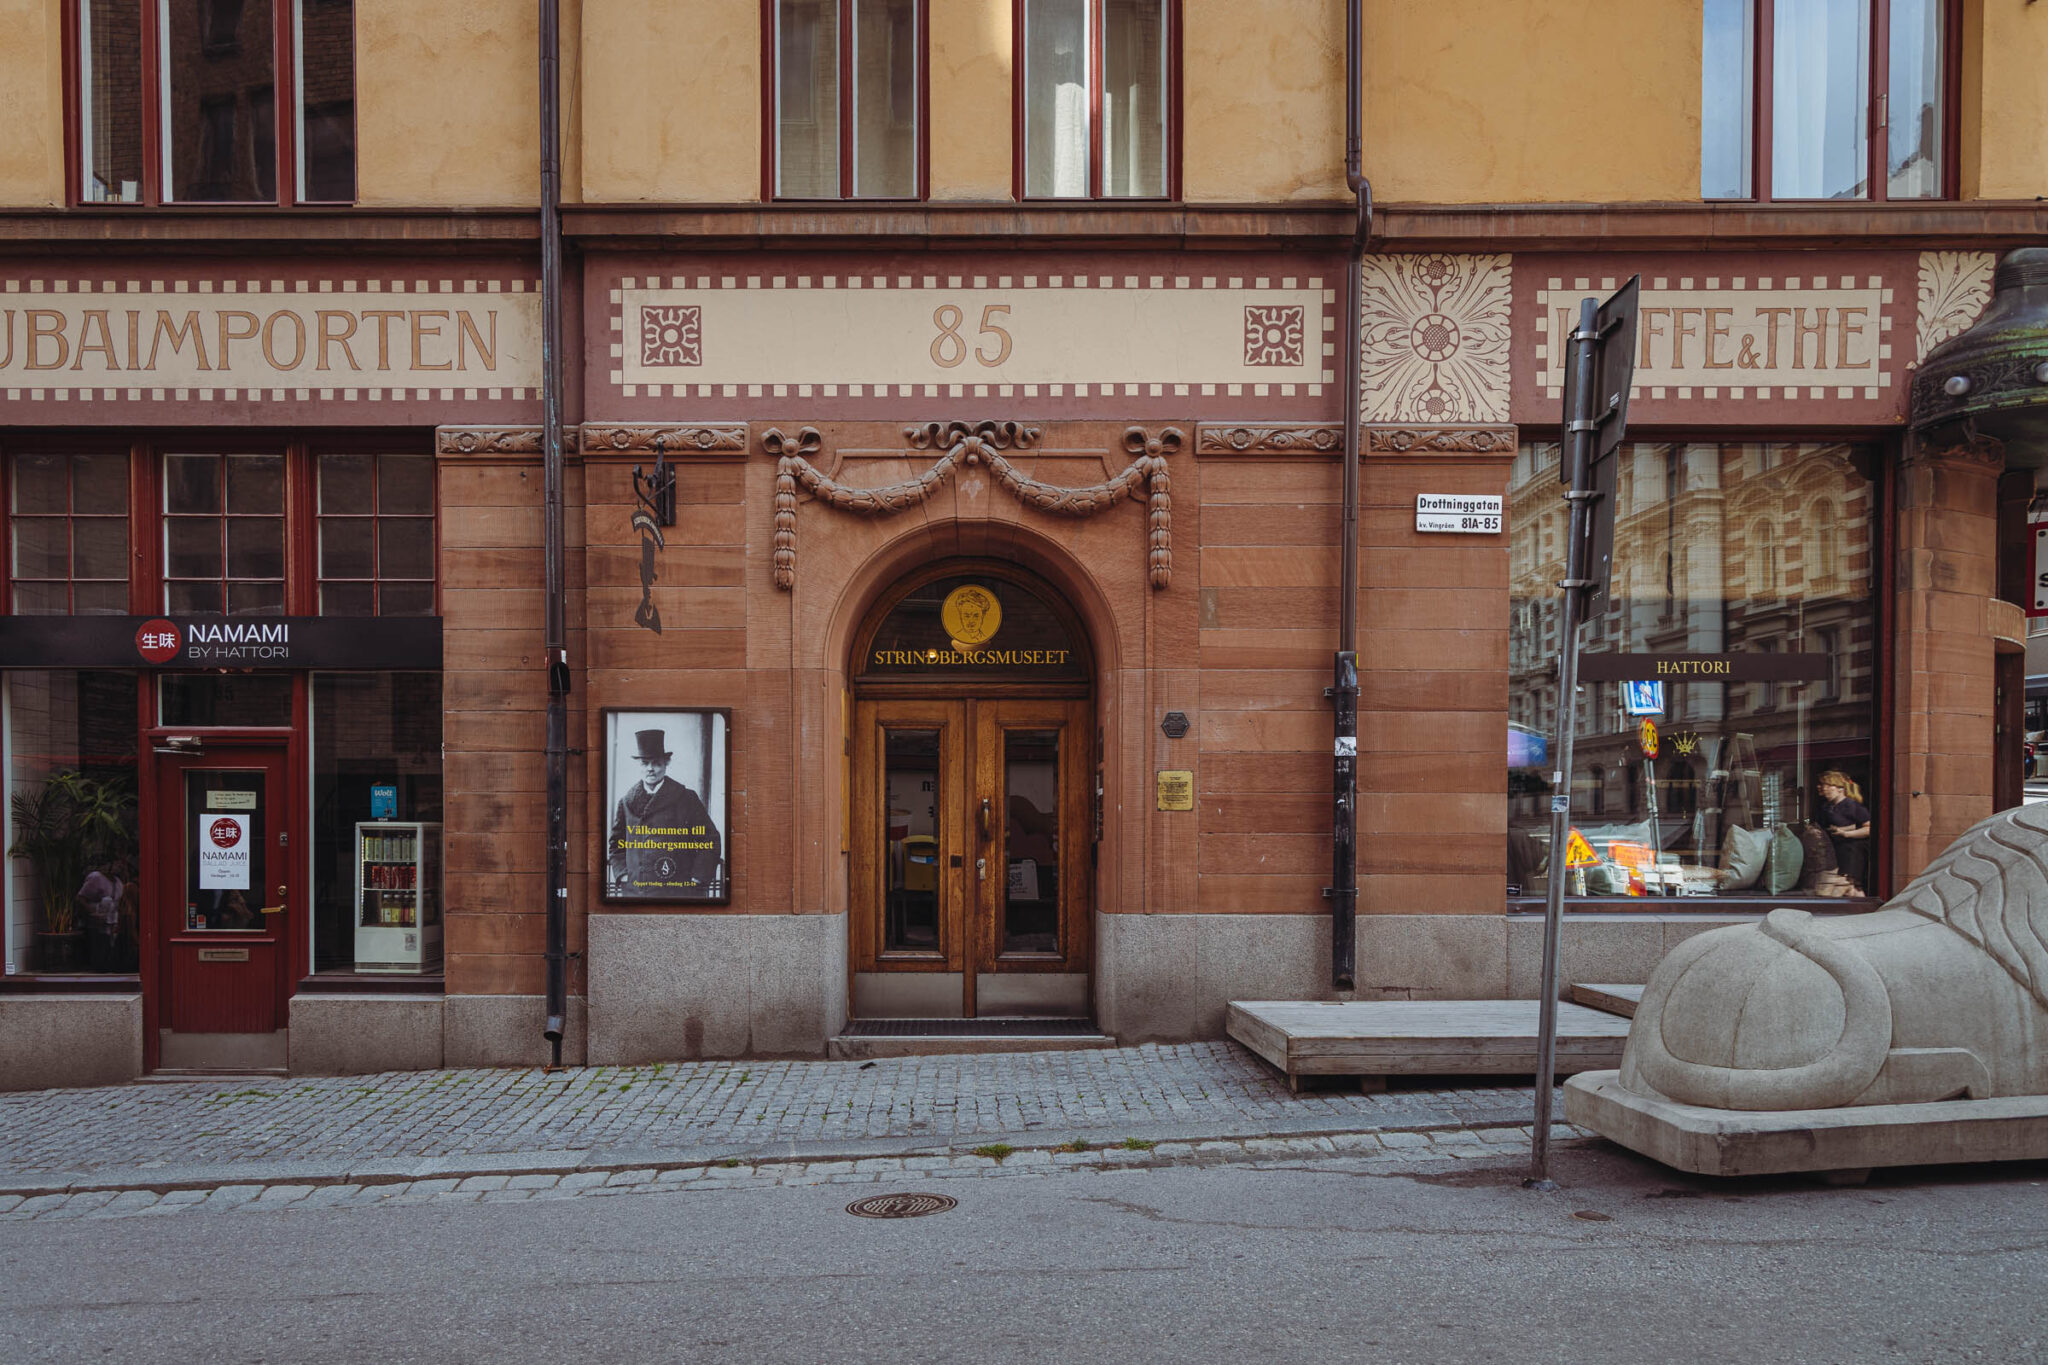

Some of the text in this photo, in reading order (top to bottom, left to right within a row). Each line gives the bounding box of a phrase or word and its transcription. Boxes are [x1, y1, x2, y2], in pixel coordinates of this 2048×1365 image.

[929, 304, 1013, 368] 85
[1419, 497, 1499, 513] Drottninggatan
[1419, 521, 1428, 529] kv.
[1462, 517, 1499, 530] 81A-85
[188, 624, 289, 643] NAMAMI
[142, 632, 176, 649] 生味
[188, 647, 289, 658] BY HATTORI
[874, 650, 1069, 665] STRINDBERGSMUSEET
[1656, 661, 1731, 674] HATTORI
[214, 827, 238, 839] 生味
[626, 825, 706, 836] Välkommen till
[617, 839, 713, 852] Strindbergsmuseet
[202, 851, 248, 860] NAMAMI
